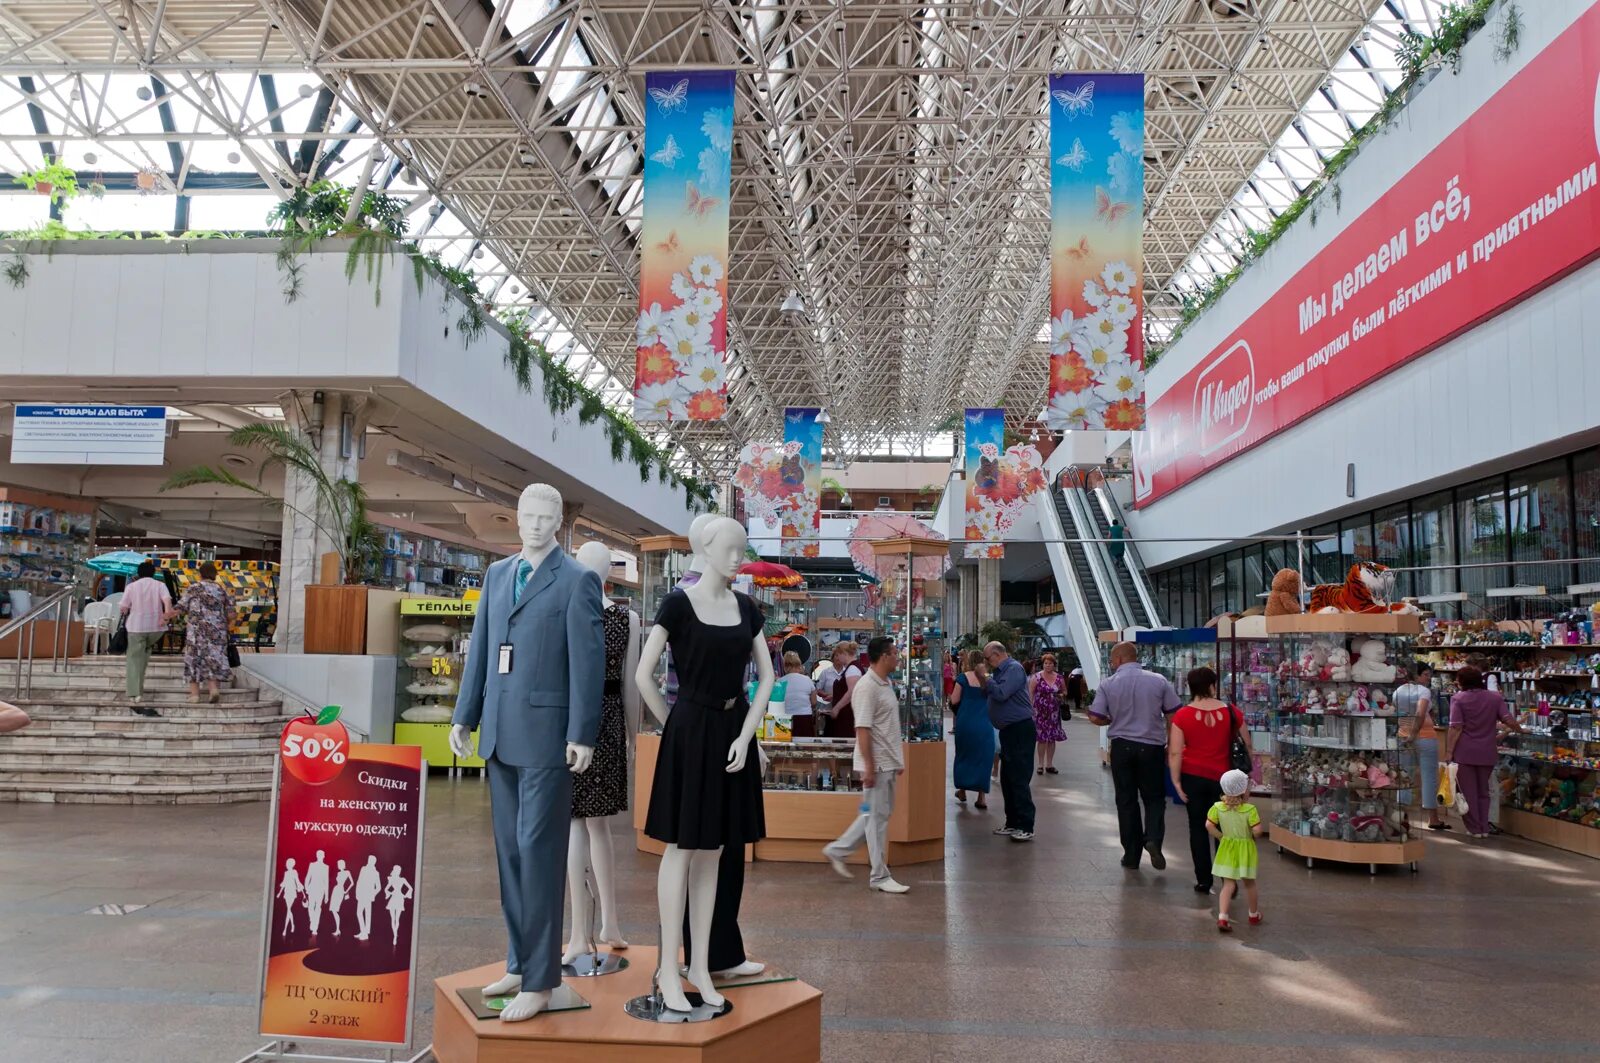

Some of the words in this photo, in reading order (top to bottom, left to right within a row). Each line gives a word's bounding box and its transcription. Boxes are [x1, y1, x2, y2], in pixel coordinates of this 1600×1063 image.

[1298, 291, 1327, 335] Мы
[1331, 228, 1409, 317] делаем
[1415, 174, 1471, 247] всё,
[1254, 378, 1280, 405] чтобы
[1280, 365, 1305, 390] ваши
[1306, 330, 1350, 373] покупки
[1352, 305, 1385, 342] были
[1388, 261, 1452, 319] лёгкими
[1456, 250, 1468, 274] и
[1472, 162, 1597, 263] приятными
[97, 408, 116, 417] ДЛЯ
[118, 408, 148, 417] БЫТА"
[416, 602, 473, 612] ТЁПЛЫЕ
[431, 657, 451, 676] 5%
[282, 733, 346, 765] 50%
[357, 770, 408, 791] Скидки
[319, 798, 335, 809] на
[338, 799, 396, 815] женскую
[398, 802, 408, 812] и
[293, 820, 354, 837] мужскую
[356, 823, 408, 839] одежду!
[284, 984, 306, 1001] ТЦ
[308, 1008, 320, 1025] 2
[321, 1013, 361, 1027] этаж
